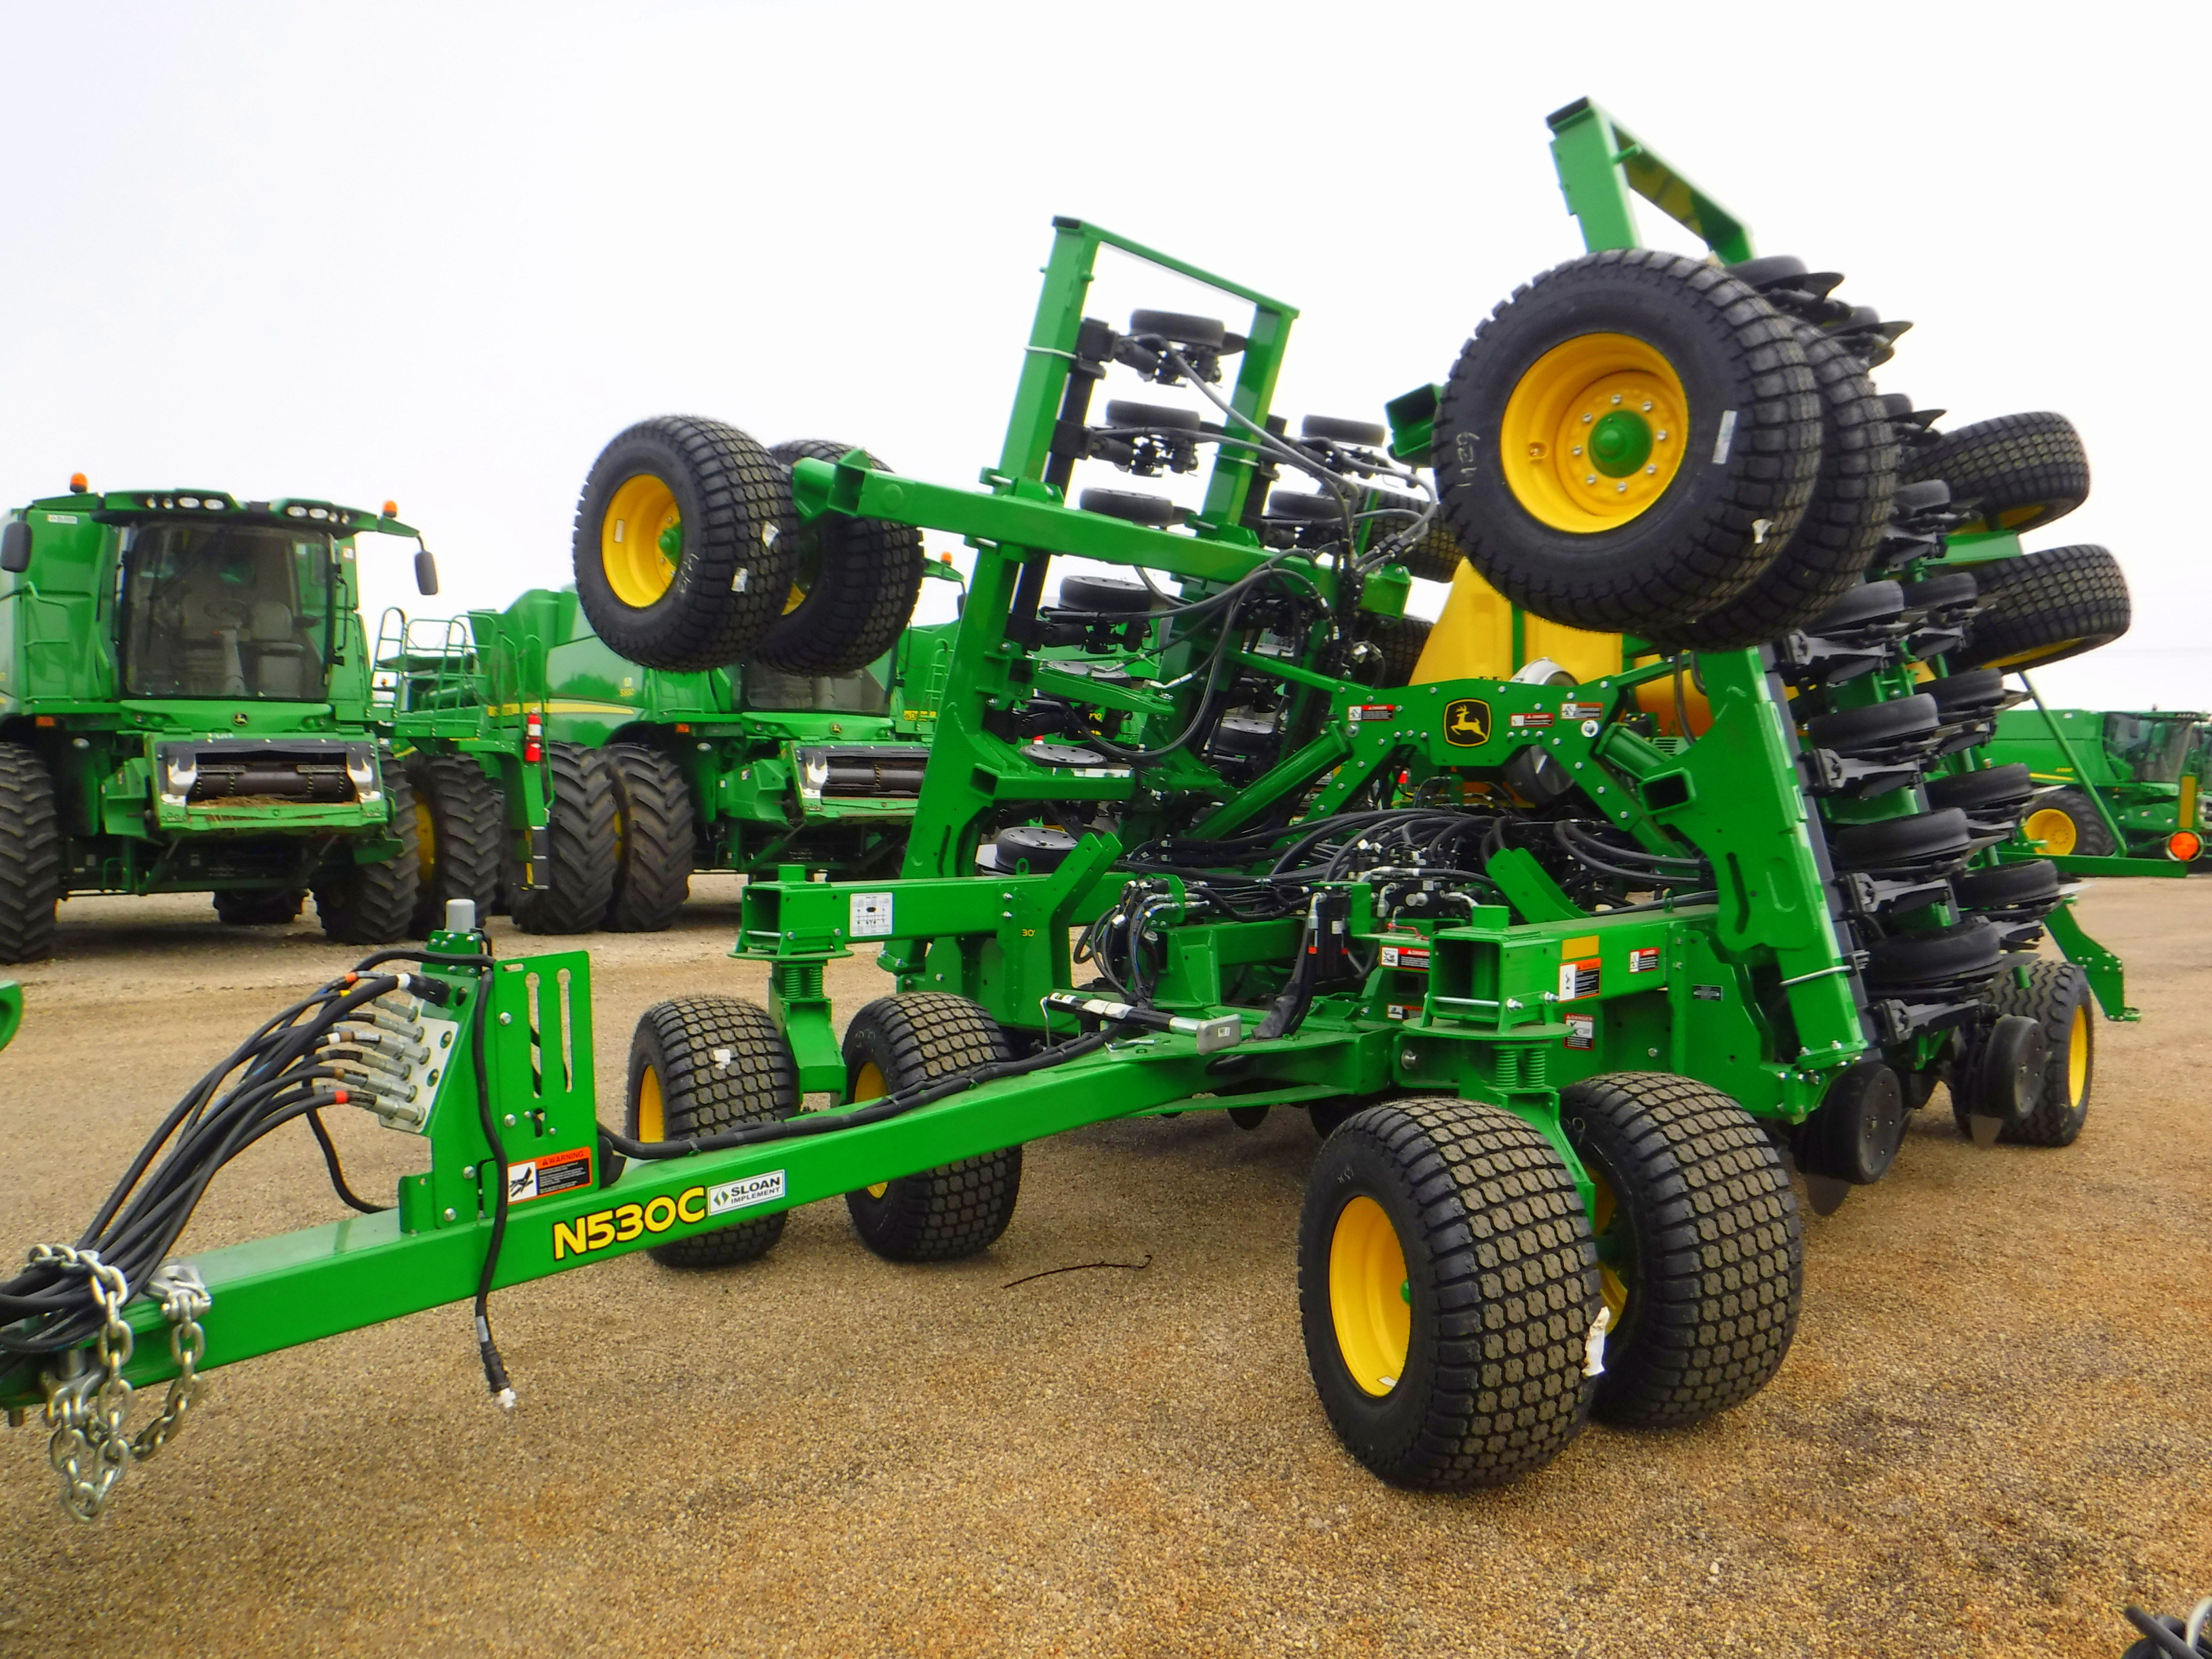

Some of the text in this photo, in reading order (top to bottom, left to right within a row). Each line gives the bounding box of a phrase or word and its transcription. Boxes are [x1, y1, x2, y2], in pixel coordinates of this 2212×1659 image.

[549, 1150, 584, 1164] WARNING
[731, 1176, 781, 1197] SLOAN
[731, 1187, 781, 1204] IMPLEMENT
[553, 1186, 707, 1261] N530C
